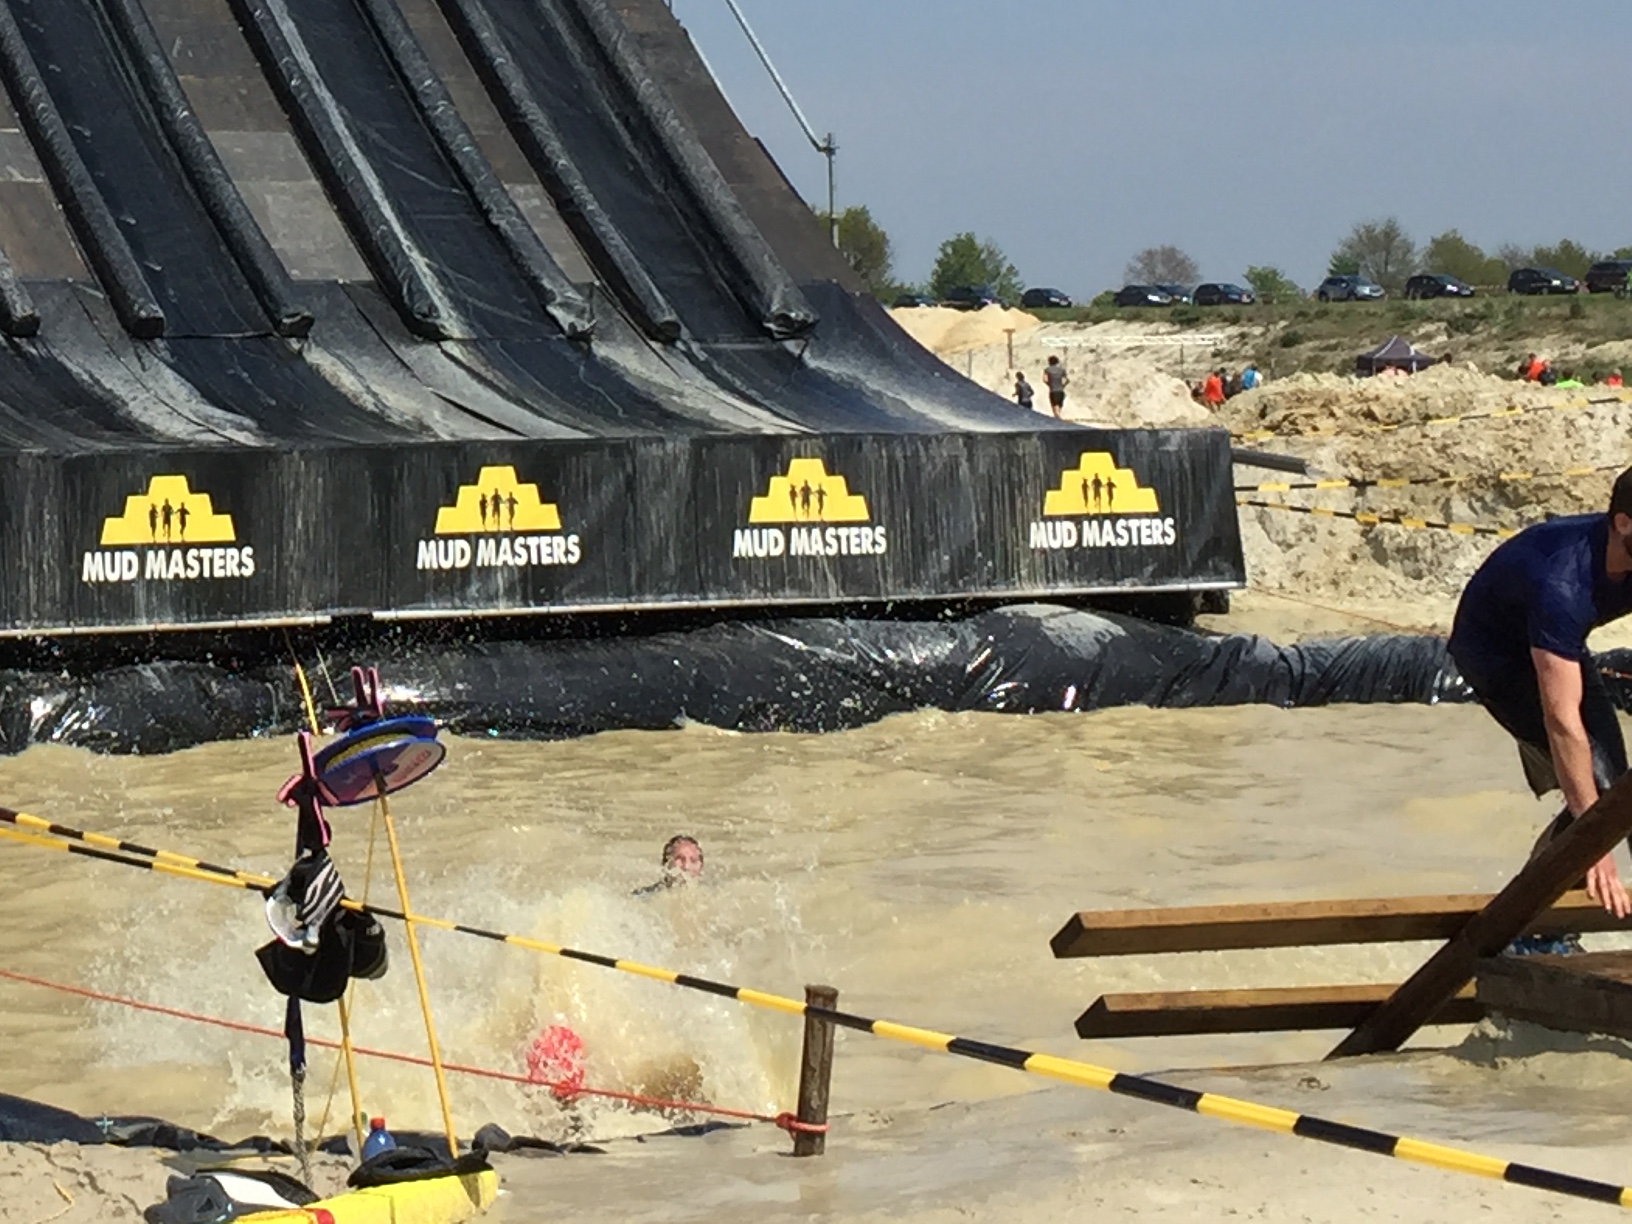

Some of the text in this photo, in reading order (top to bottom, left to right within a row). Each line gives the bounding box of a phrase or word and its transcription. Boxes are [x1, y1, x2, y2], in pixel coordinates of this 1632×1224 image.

[733, 525, 888, 559] MUD MASTERS
[1029, 517, 1176, 550] MUD MASTERS
[81, 546, 256, 583] MUD MASTERS
[416, 534, 581, 571] MUD MASTERS
